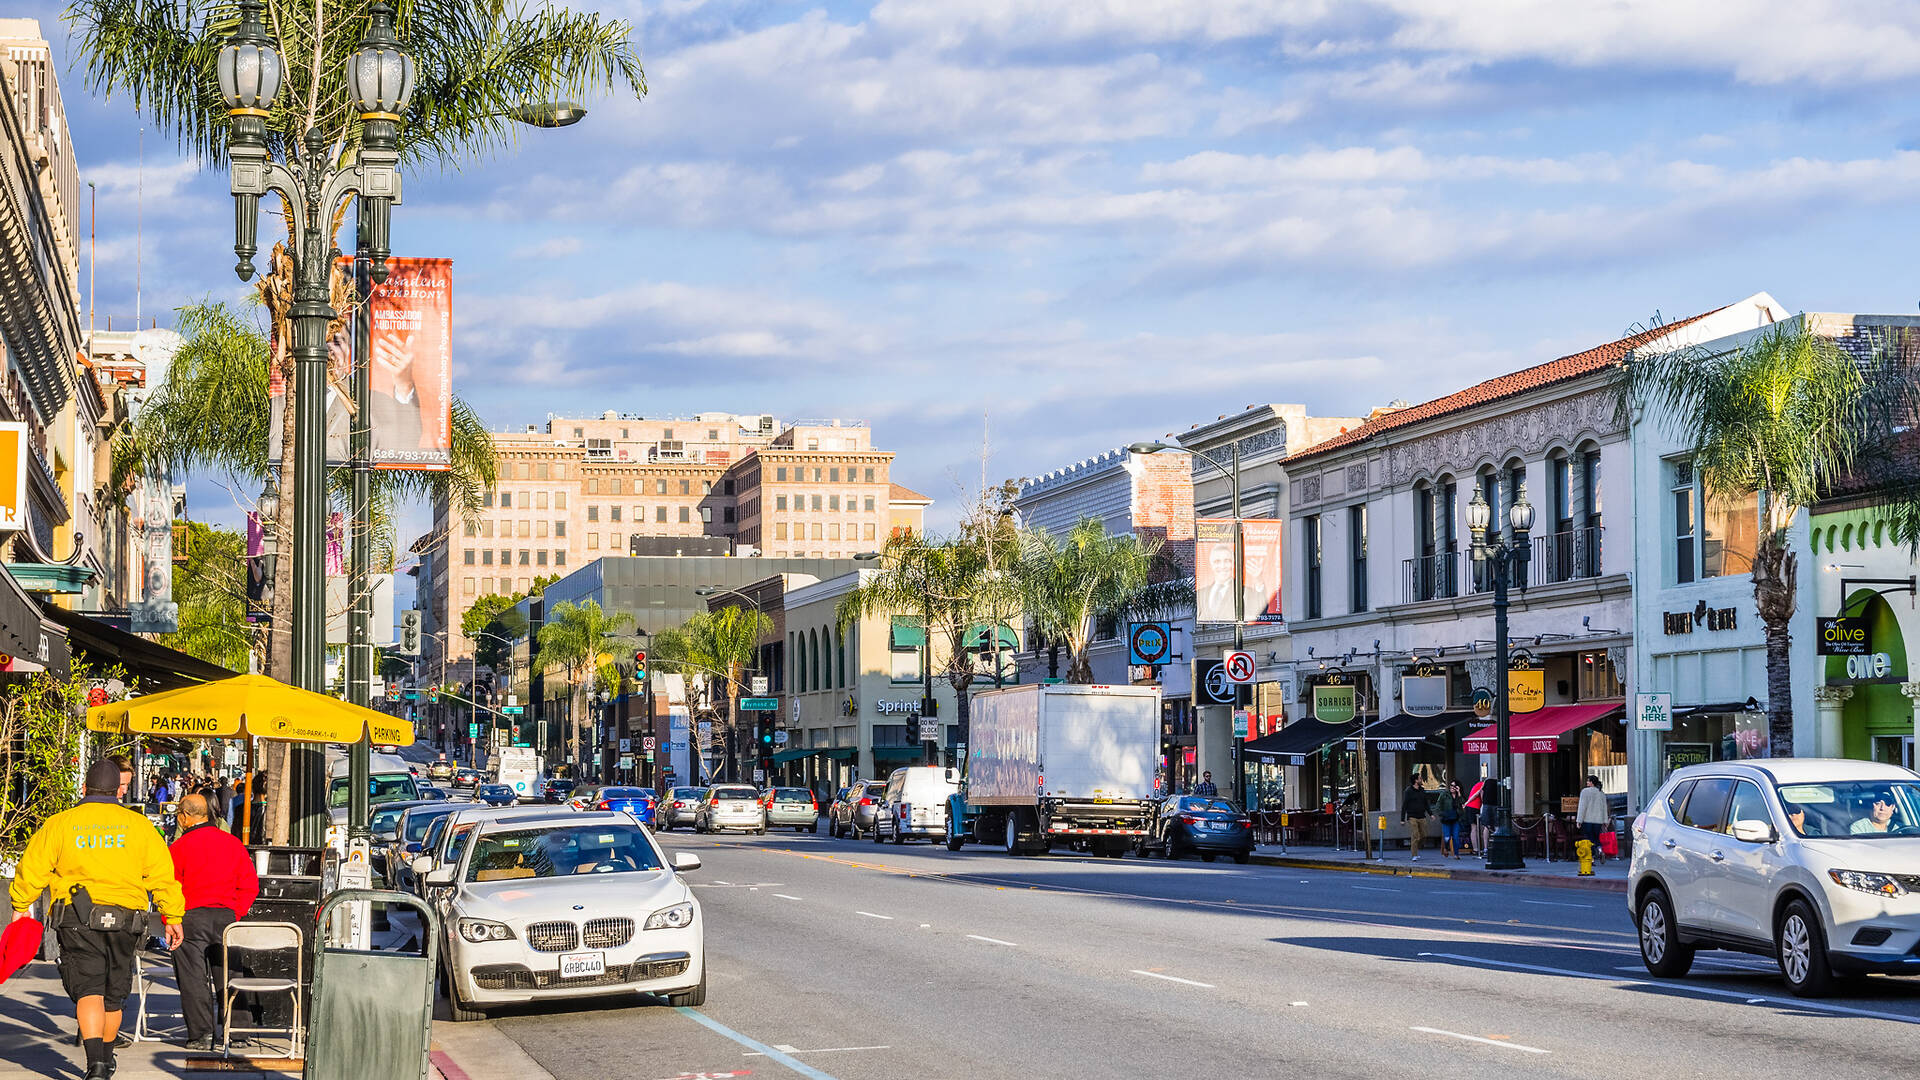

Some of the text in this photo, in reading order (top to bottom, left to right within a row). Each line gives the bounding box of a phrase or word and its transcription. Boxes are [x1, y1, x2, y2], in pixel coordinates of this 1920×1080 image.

[383, 268, 449, 288] asadena
[379, 288, 444, 299] SYMPHONY
[374, 320, 422, 331] AUDITORIUM
[1824, 625, 1865, 641] olive
[1513, 659, 1530, 670] 38
[1416, 667, 1432, 677] 42
[1327, 675, 1341, 685] 46
[877, 699, 919, 716] Sprint
[1318, 697, 1352, 707] SORRISO
[1645, 705, 1663, 713] PAY
[1641, 713, 1667, 722] HERE
[151, 716, 218, 731] PARKING
[278, 721, 286, 729] P
[374, 726, 401, 742] PARKING
[1532, 741, 1552, 751] LOUNGE
[75, 834, 126, 849] GUIDE
[564, 960, 602, 974] 6RBC440
